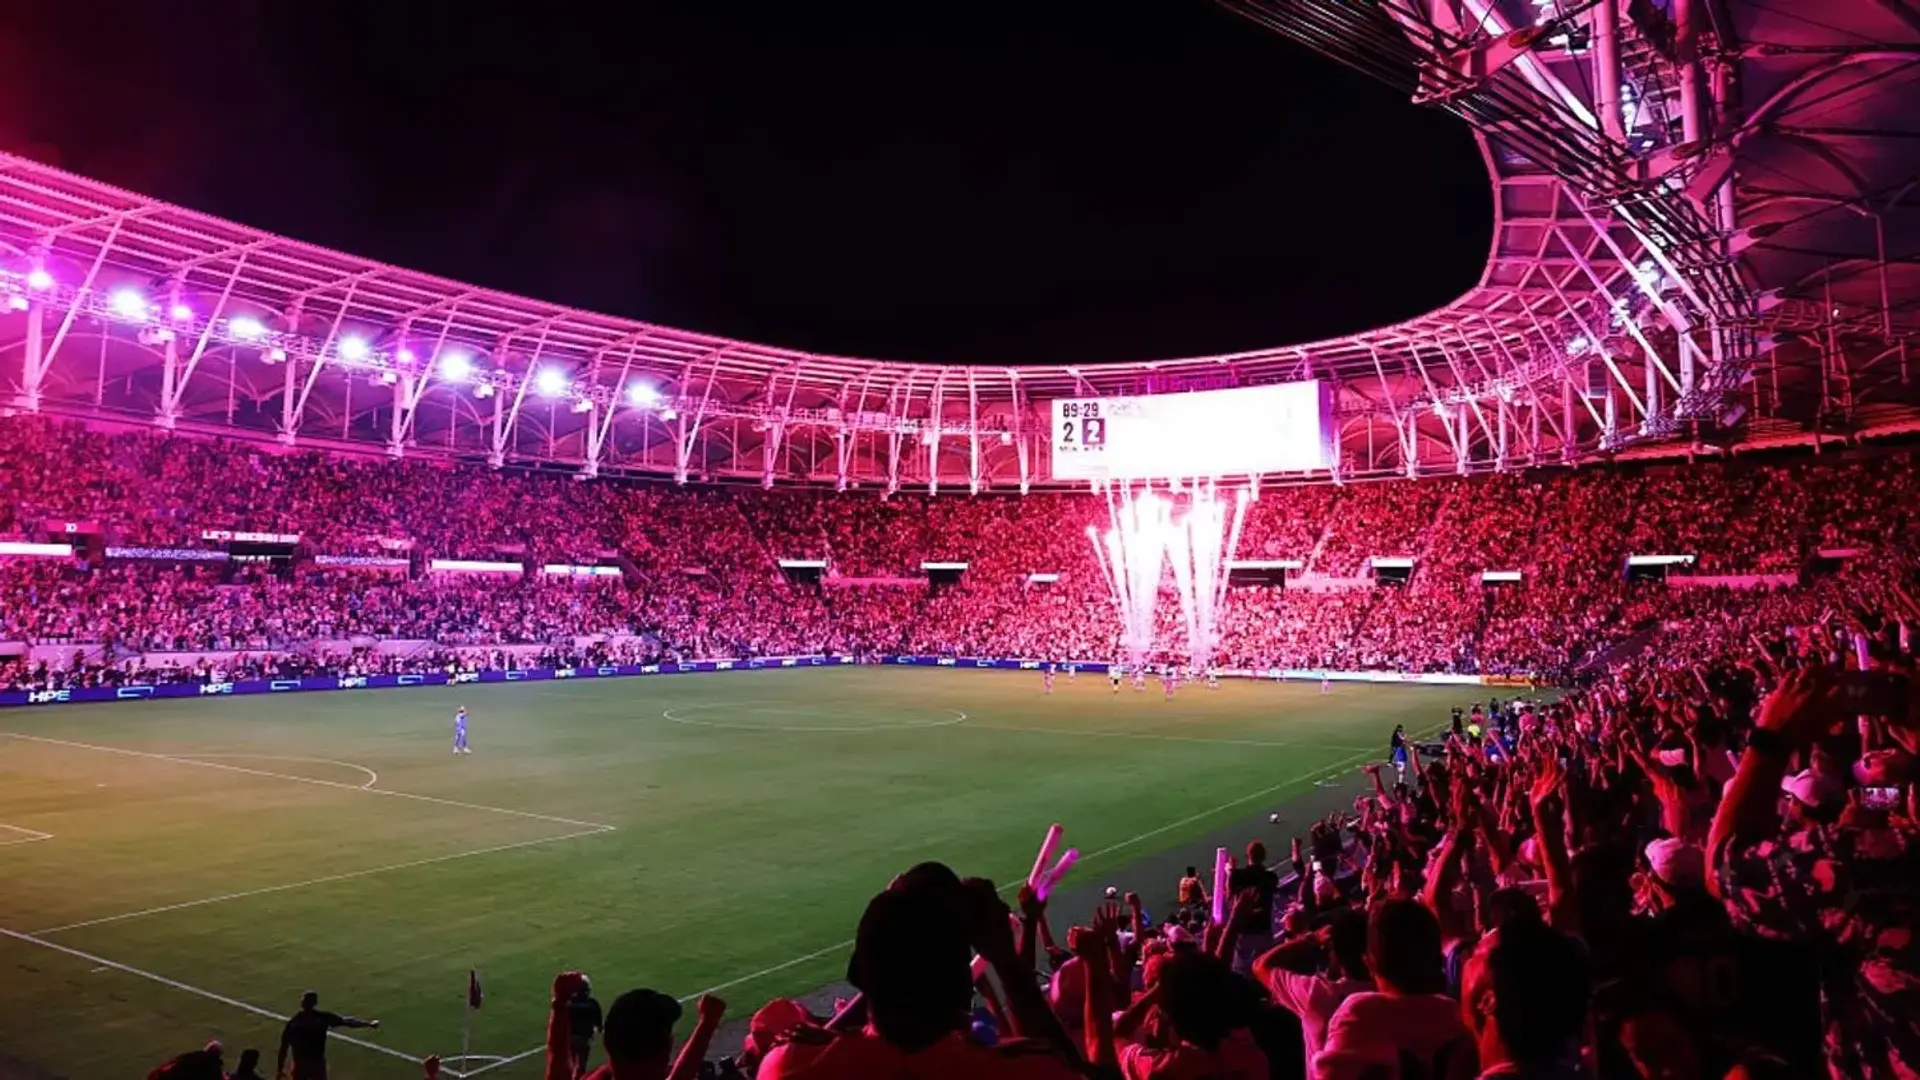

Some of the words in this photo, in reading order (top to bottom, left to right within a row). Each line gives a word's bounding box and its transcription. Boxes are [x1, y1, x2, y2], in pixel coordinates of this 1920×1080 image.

[1063, 402, 1099, 418] 89:29
[1063, 421, 1074, 442] 2
[1087, 420, 1100, 442] 2
[28, 689, 71, 702] HPE
[199, 682, 234, 695] HPE
